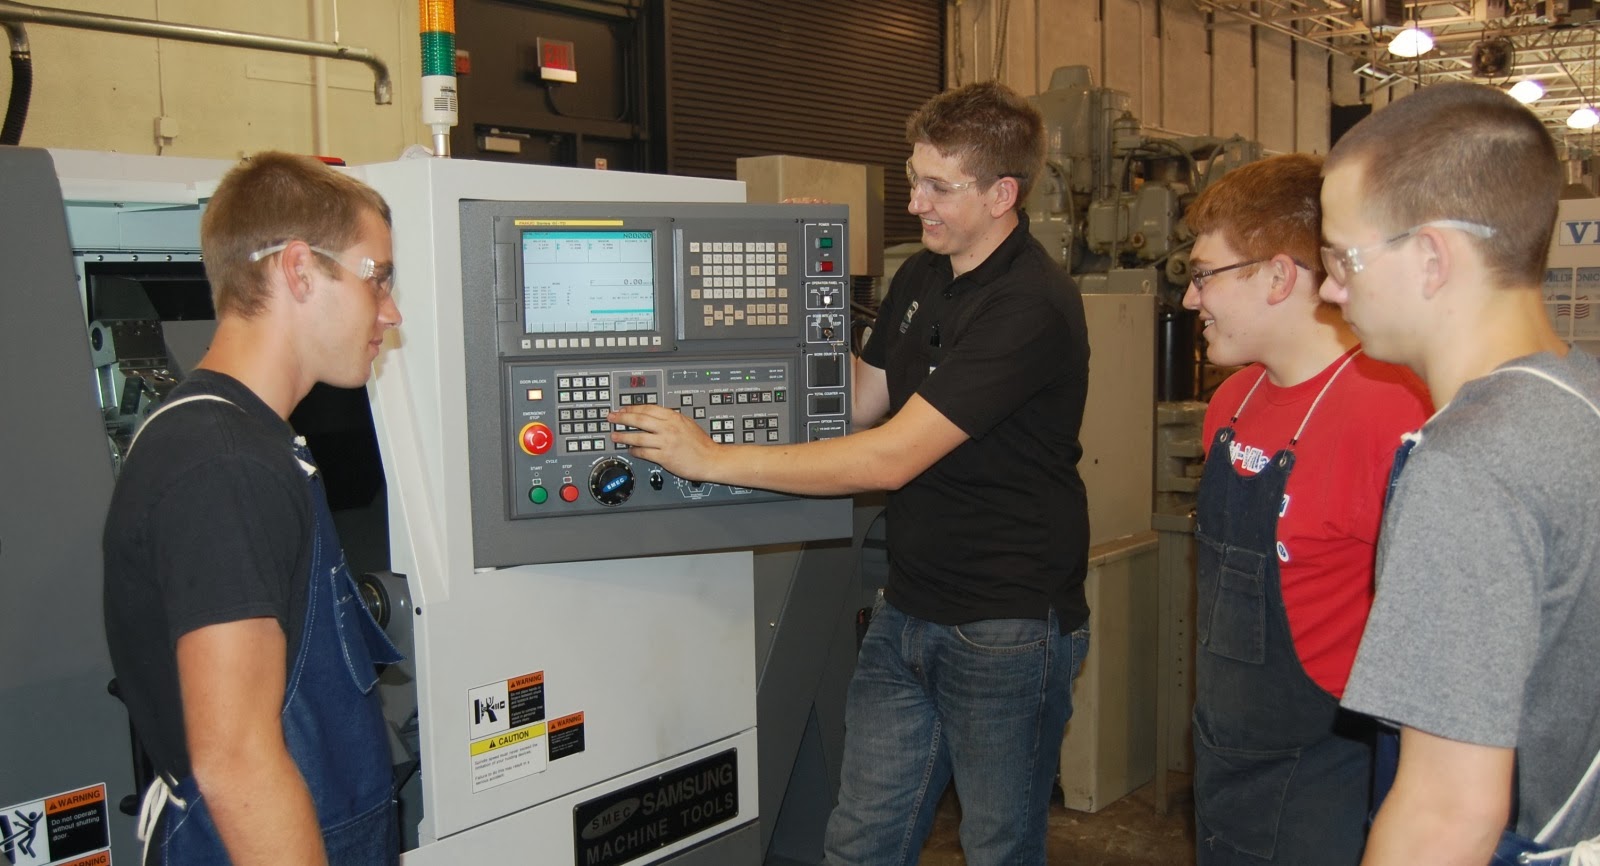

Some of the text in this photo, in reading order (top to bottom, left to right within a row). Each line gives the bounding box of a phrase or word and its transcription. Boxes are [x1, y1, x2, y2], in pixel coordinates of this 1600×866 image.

[606, 477, 625, 490] SMEC
[516, 674, 542, 686] WARNING
[557, 714, 582, 727] WARNING
[498, 730, 529, 745] CAUTION
[58, 790, 100, 808] WARNING
[592, 763, 733, 830] SMEC SAMSUNG
[74, 809, 97, 820] operate
[53, 816, 100, 833] without shutting
[586, 792, 734, 866] MACHINE TOOLS
